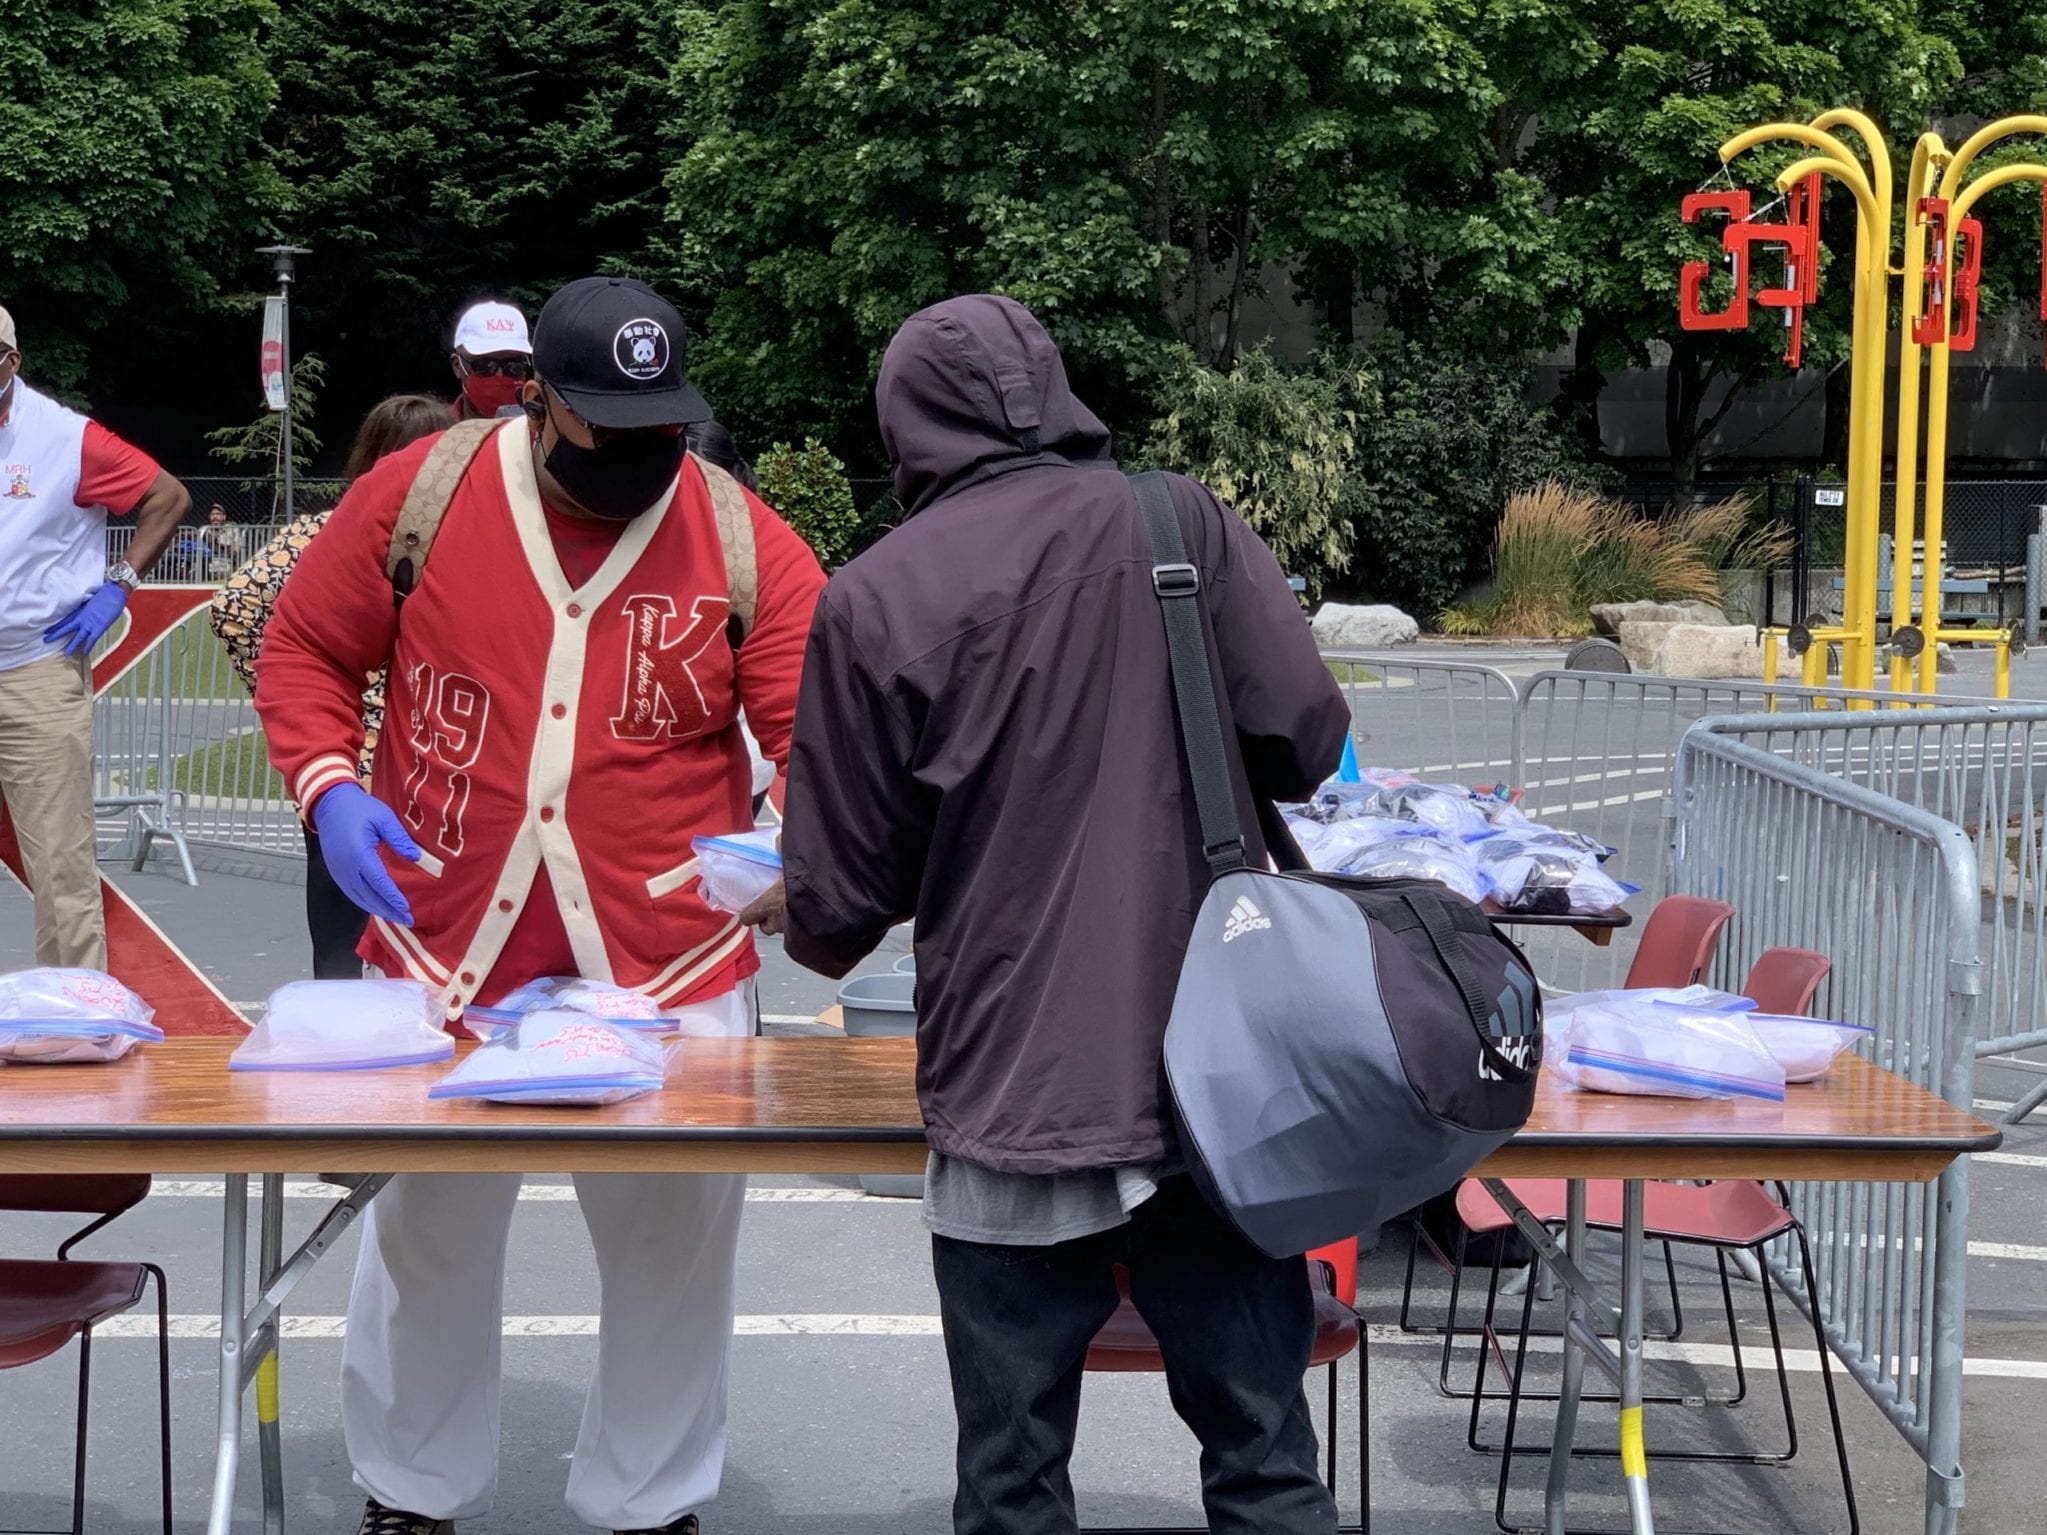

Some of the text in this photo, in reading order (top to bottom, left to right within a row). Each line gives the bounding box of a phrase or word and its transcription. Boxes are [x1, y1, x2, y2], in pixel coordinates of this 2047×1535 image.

[5, 464, 32, 474] MRH
[641, 603, 660, 647] Kappa
[636, 650, 656, 695] Alpha
[1222, 917, 1272, 943] adidas
